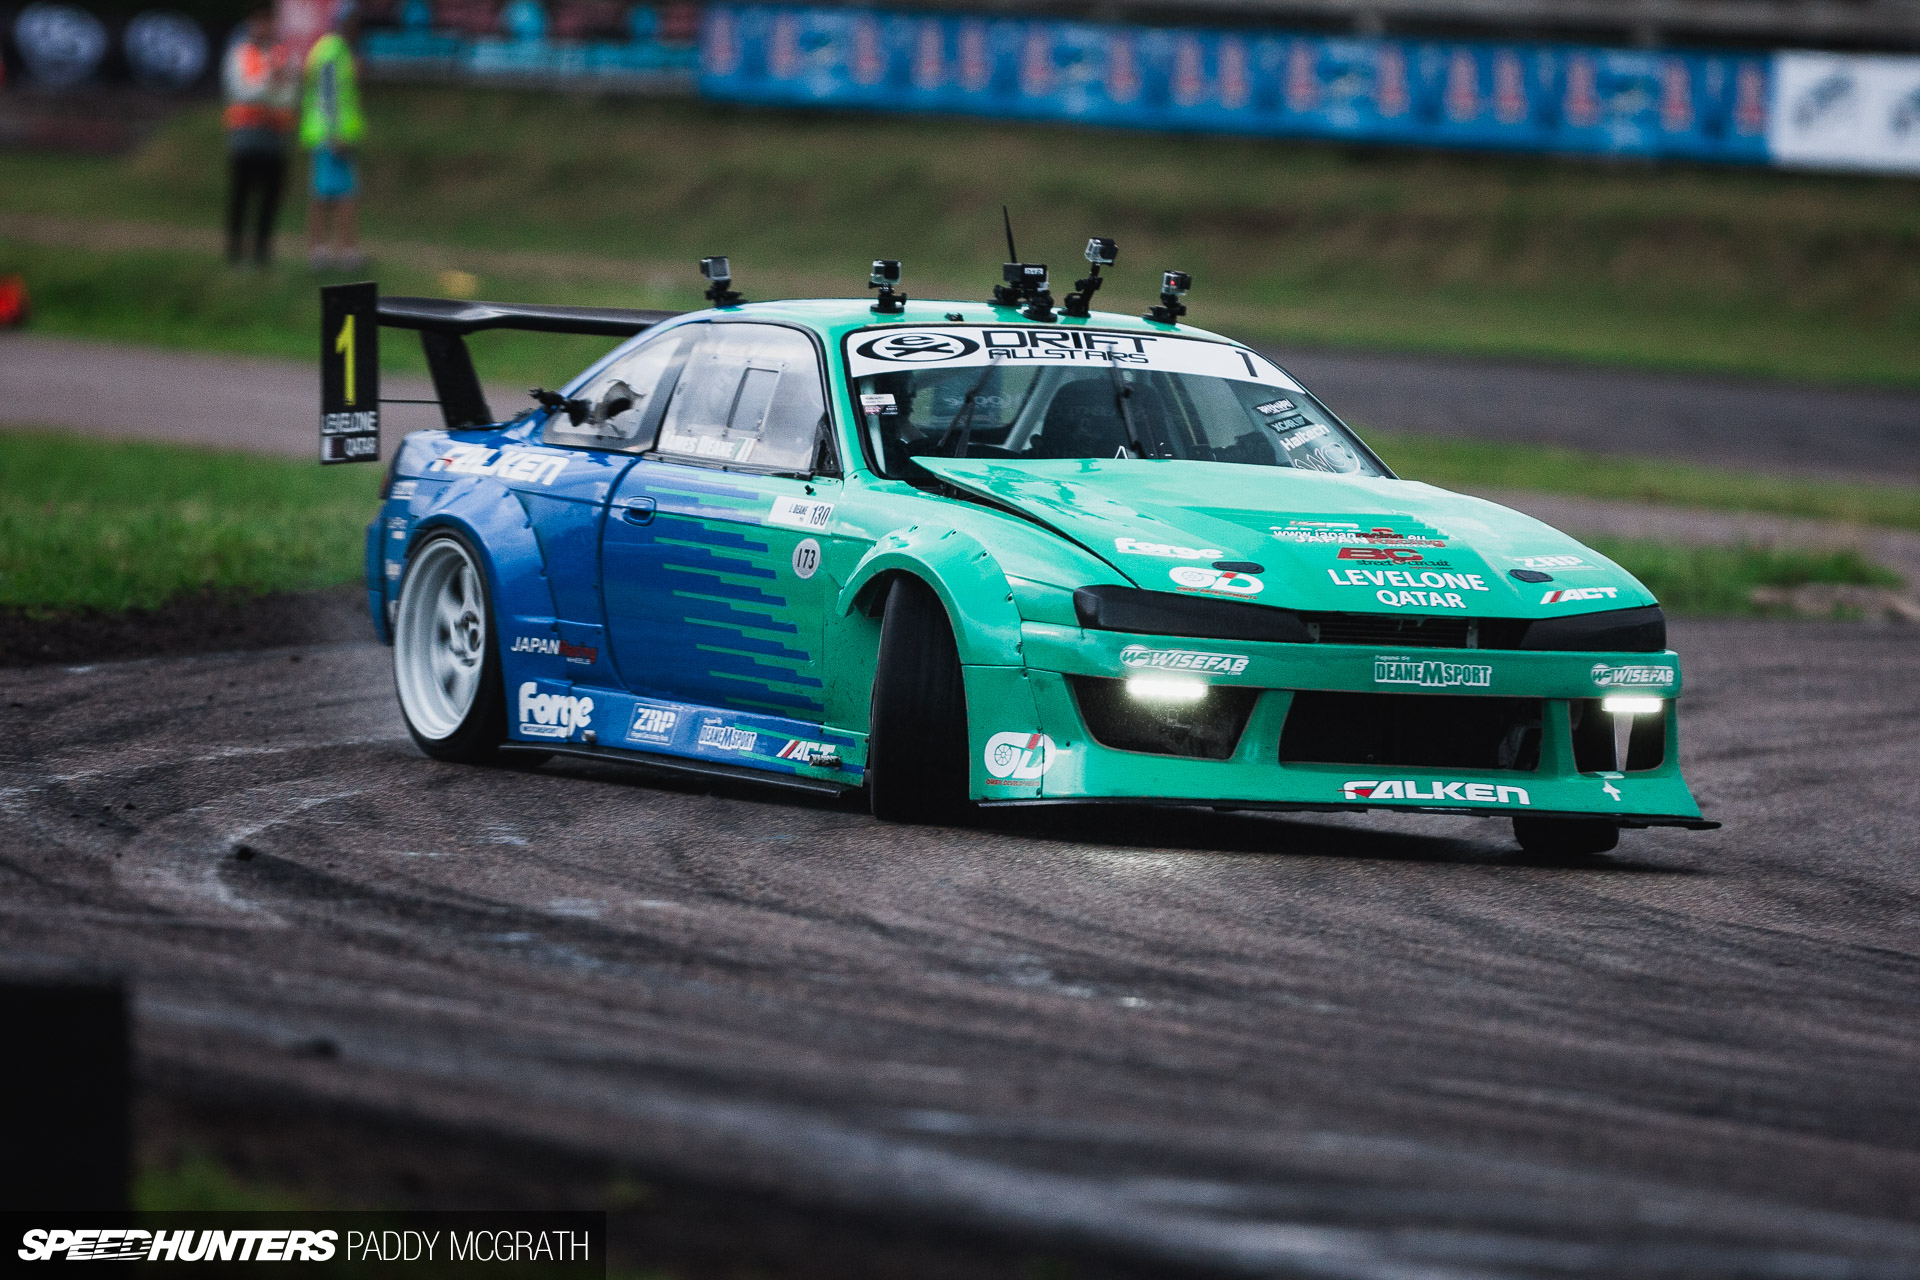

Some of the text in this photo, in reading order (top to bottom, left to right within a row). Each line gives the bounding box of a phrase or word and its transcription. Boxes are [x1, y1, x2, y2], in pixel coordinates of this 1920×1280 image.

[982, 330, 1157, 353] DRIFT
[335, 314, 356, 406] 1
[988, 349, 1149, 364] ALLSTARS
[1235, 350, 1258, 377] 1
[1280, 424, 1330, 451] Haltech
[429, 446, 569, 486] FALKEN
[810, 505, 831, 526] 130
[797, 548, 816, 569] 173
[1337, 548, 1423, 562] BC
[1327, 568, 1490, 591] LEVELONE
[1376, 589, 1468, 609] QATAR
[511, 637, 560, 655] JAPAN
[1150, 650, 1249, 672] WISEFAB
[1613, 669, 1674, 683] WISEFAB
[519, 681, 594, 737] Forge
[1342, 780, 1531, 805] FALKEN
